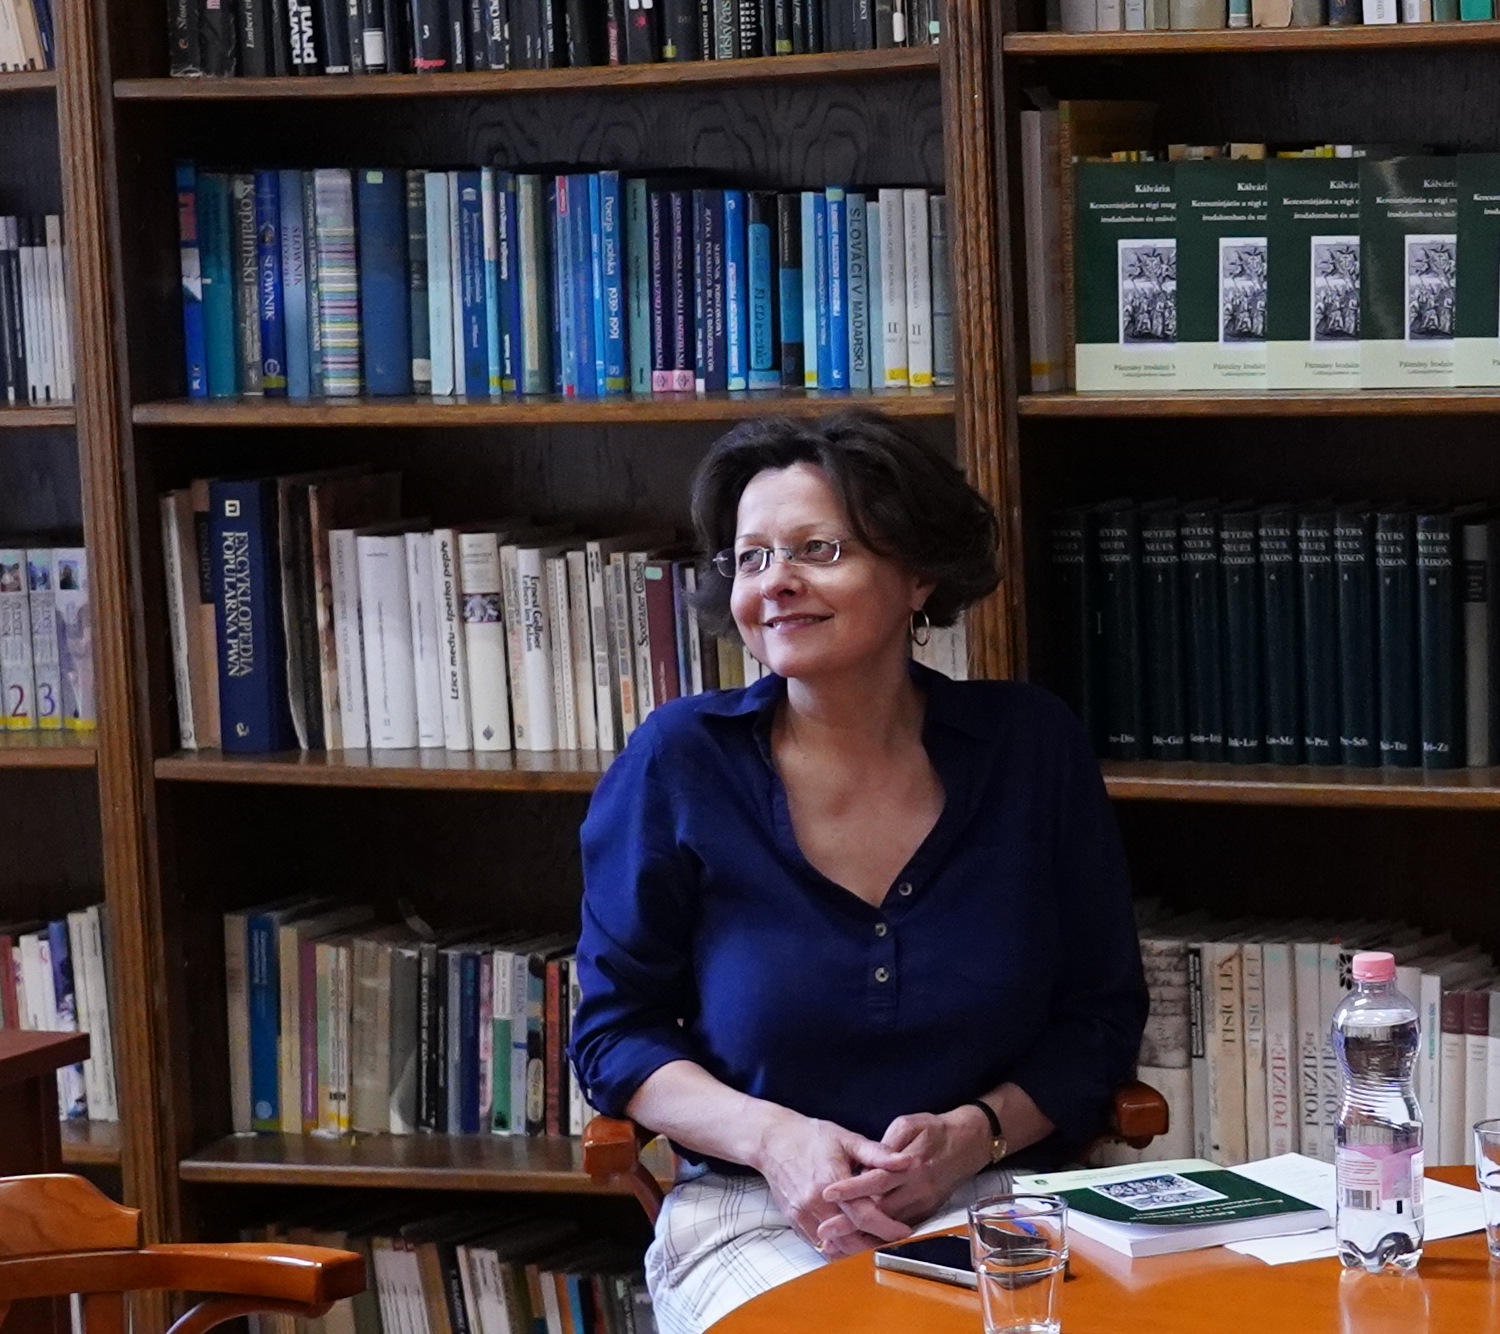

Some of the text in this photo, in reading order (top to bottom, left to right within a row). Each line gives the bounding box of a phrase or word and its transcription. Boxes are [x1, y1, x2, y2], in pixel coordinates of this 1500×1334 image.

[301, 2, 318, 65] první
[1134, 184, 1171, 194] Kálvária
[238, 183, 257, 283] Kopaliński
[603, 196, 620, 340] Poezja polska 1939-1991
[850, 207, 864, 280] SLOVÁCI
[264, 255, 275, 321] SŁOWNIK
[222, 530, 240, 677] POPULARNA PWN
[236, 531, 254, 676] ENCYKLOPEDIA
[1272, 1045, 1288, 1128] POEZIE
[1303, 1045, 1319, 1127] POEZIE
[1324, 1045, 1339, 1127] POEZIE
